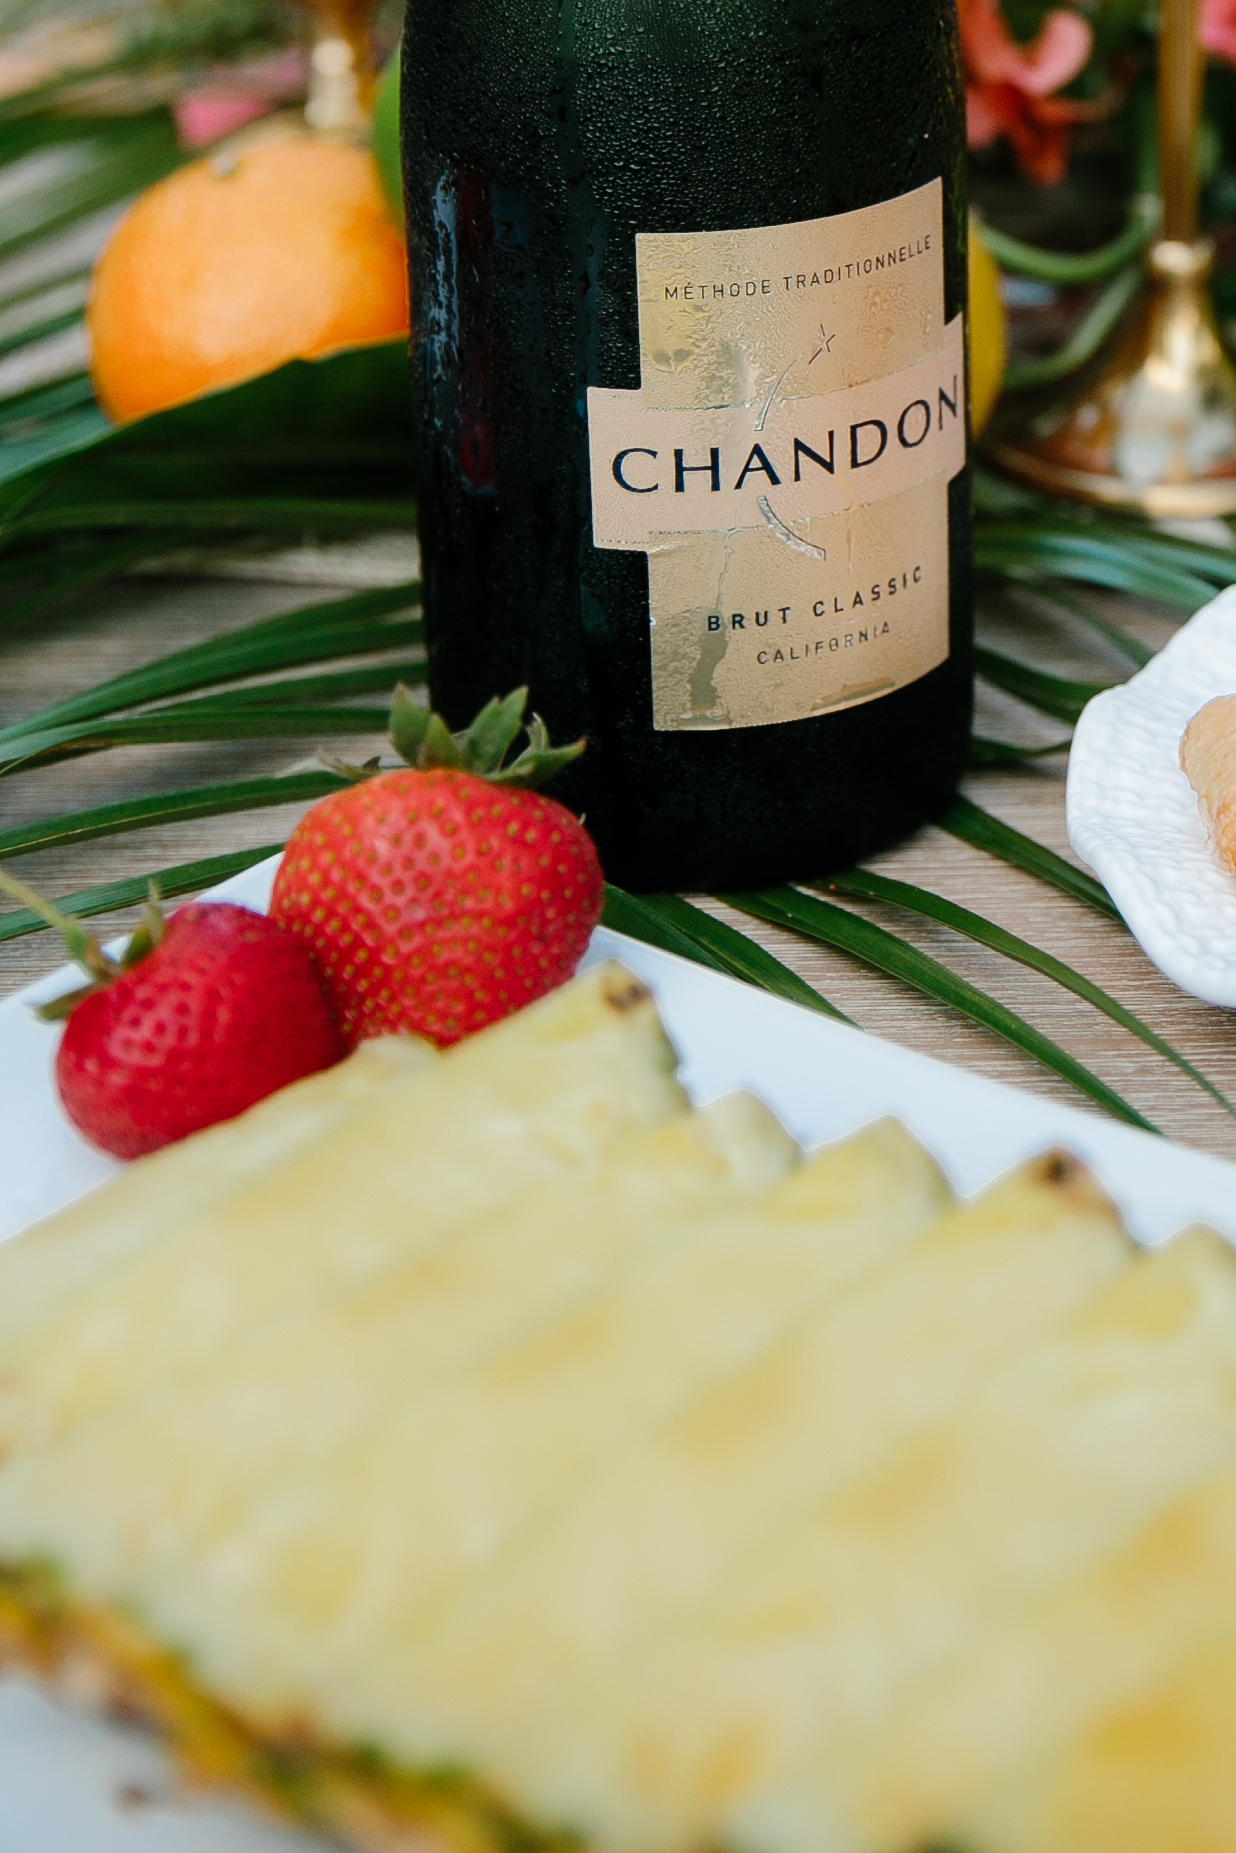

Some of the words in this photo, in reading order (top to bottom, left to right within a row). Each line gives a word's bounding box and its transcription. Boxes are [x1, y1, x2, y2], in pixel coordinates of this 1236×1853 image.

[664, 277, 772, 301] MÉTHODE
[782, 235, 933, 292] TRADITIONNELLE
[611, 374, 960, 494] CHANDON
[707, 606, 793, 633] BRUT
[812, 565, 923, 618] CLASSIC
[756, 620, 892, 666] CALIFORNIA
